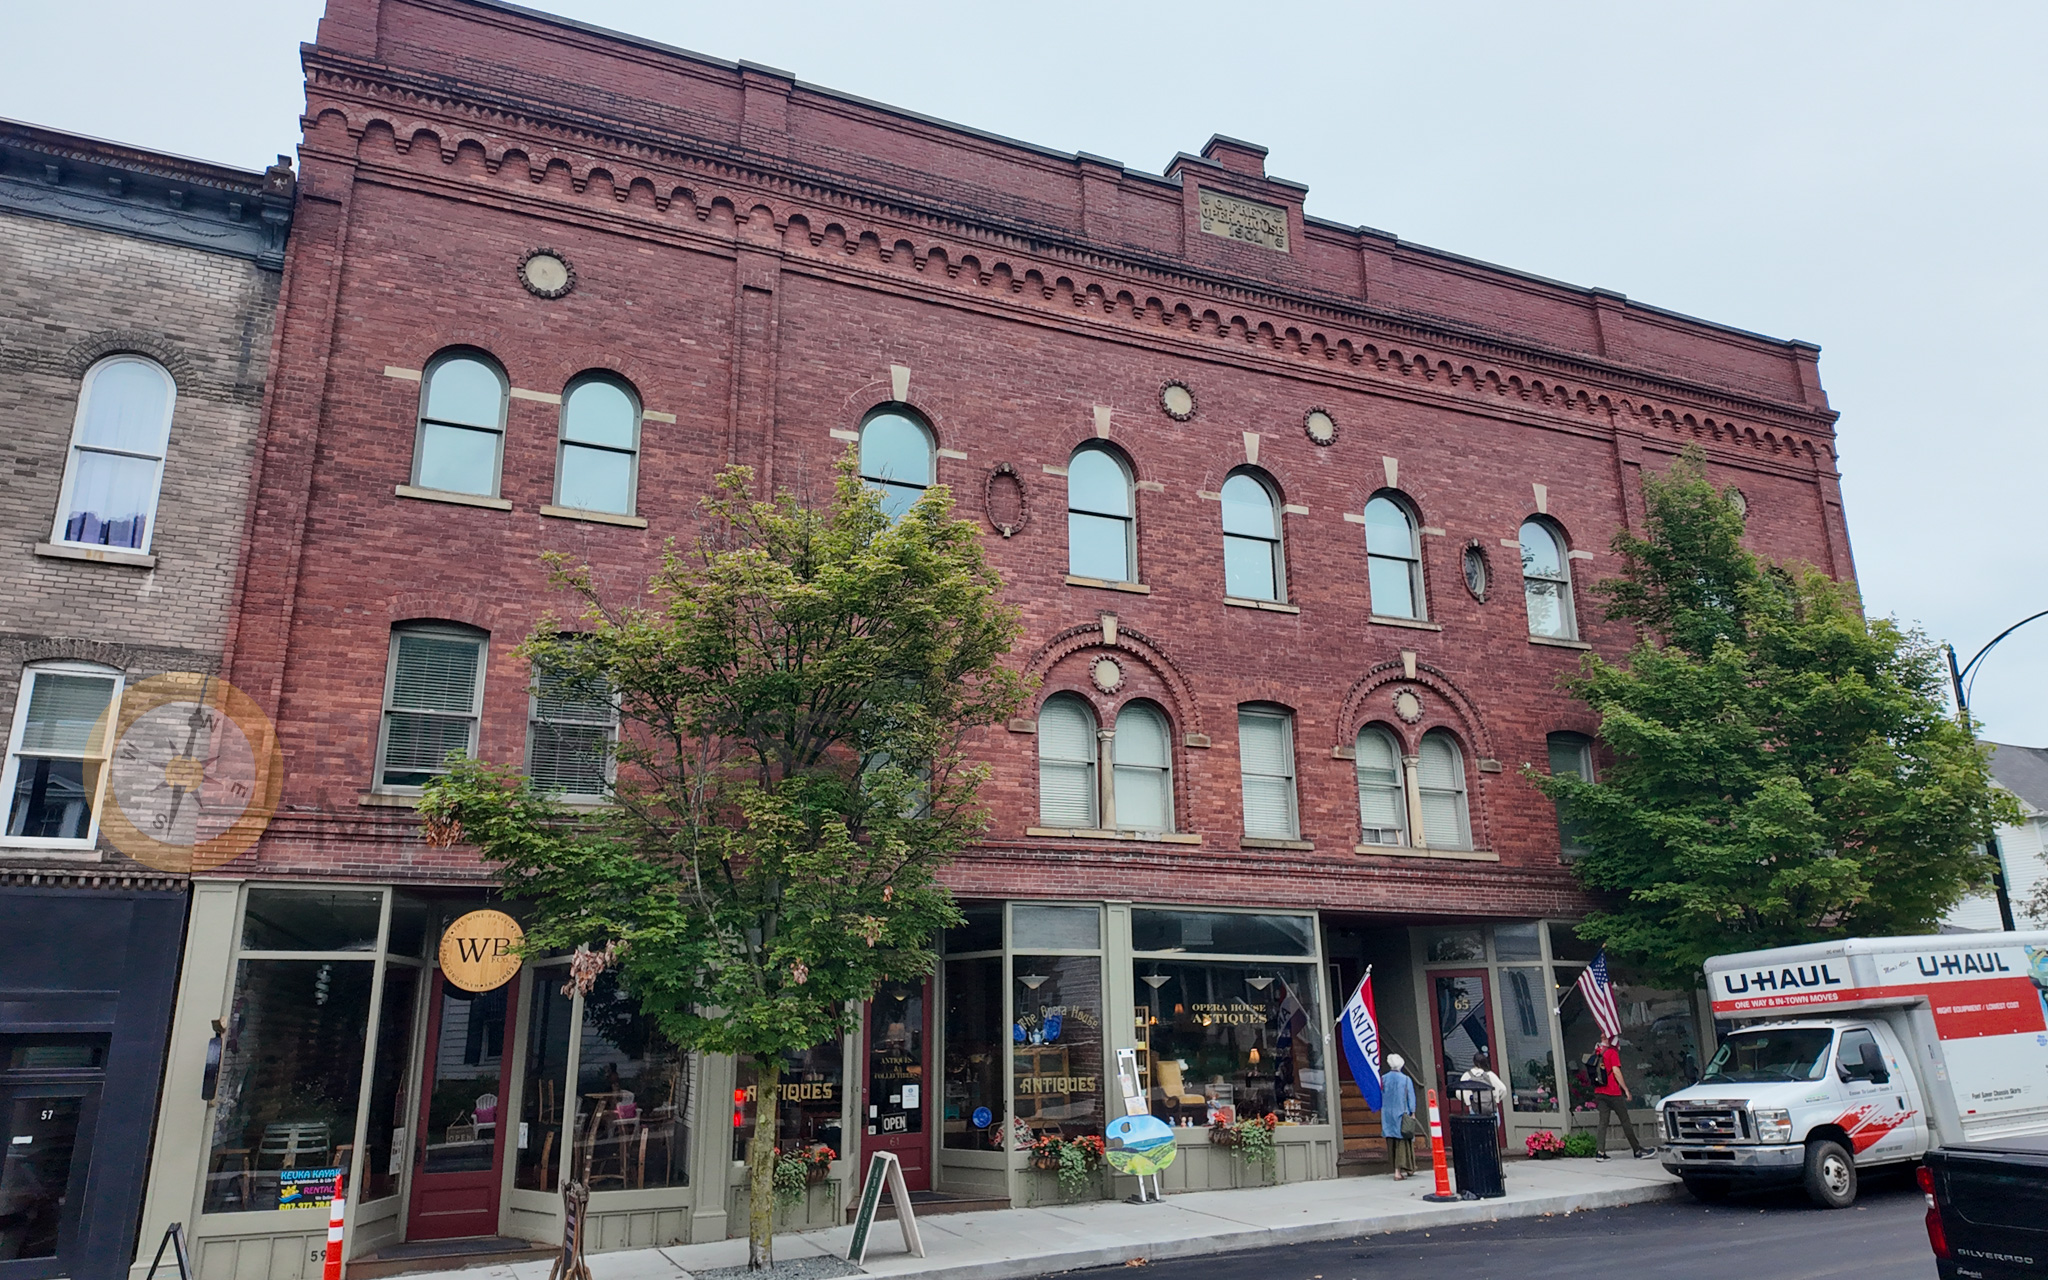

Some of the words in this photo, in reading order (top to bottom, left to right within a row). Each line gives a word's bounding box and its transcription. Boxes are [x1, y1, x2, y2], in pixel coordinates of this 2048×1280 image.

[1202, 208, 1243, 228] OPERA
[1243, 217, 1285, 238] HOUSE
[453, 921, 464, 932] THE
[466, 913, 484, 922] WINE
[456, 937, 511, 963] WB
[1917, 952, 2010, 977] U-HAUL
[1724, 964, 1841, 994] U-HAUL
[1191, 1003, 1227, 1012] OPERA
[1230, 1004, 1266, 1012] HOUSE
[1454, 1000, 1469, 1010] 65
[1735, 1001, 1750, 1009] ONE
[1752, 999, 1767, 1007] WAY
[1775, 995, 1809, 1005] IN-TOWN
[1809, 993, 1838, 1003] MOVES
[1953, 1004, 1981, 1013] EQUIPMENT
[1985, 1002, 2006, 1011] LOWEST
[2006, 1001, 2020, 1009] COST
[1017, 1013, 1038, 1030] The
[1040, 1005, 1067, 1020] Opera
[1070, 1005, 1099, 1029] House
[1192, 1013, 1268, 1026] ANTIQUES
[1351, 1004, 1381, 1070] ANTIQU
[881, 1057, 913, 1065] ANTIQUES
[743, 1082, 834, 1102] AIQUES
[1020, 1077, 1096, 1095] ANTIQUES
[1981, 1091, 1993, 1099] Saver
[41, 1110, 53, 1120] 57
[883, 1116, 906, 1131] OPEN
[448, 1133, 473, 1142] OPEN
[890, 1137, 900, 1146] 61
[280, 1170, 310, 1180] KEUKA
[312, 1168, 342, 1178] KAYAK
[310, 1250, 327, 1262] 59
[1957, 1248, 2034, 1264] SILVERADO
